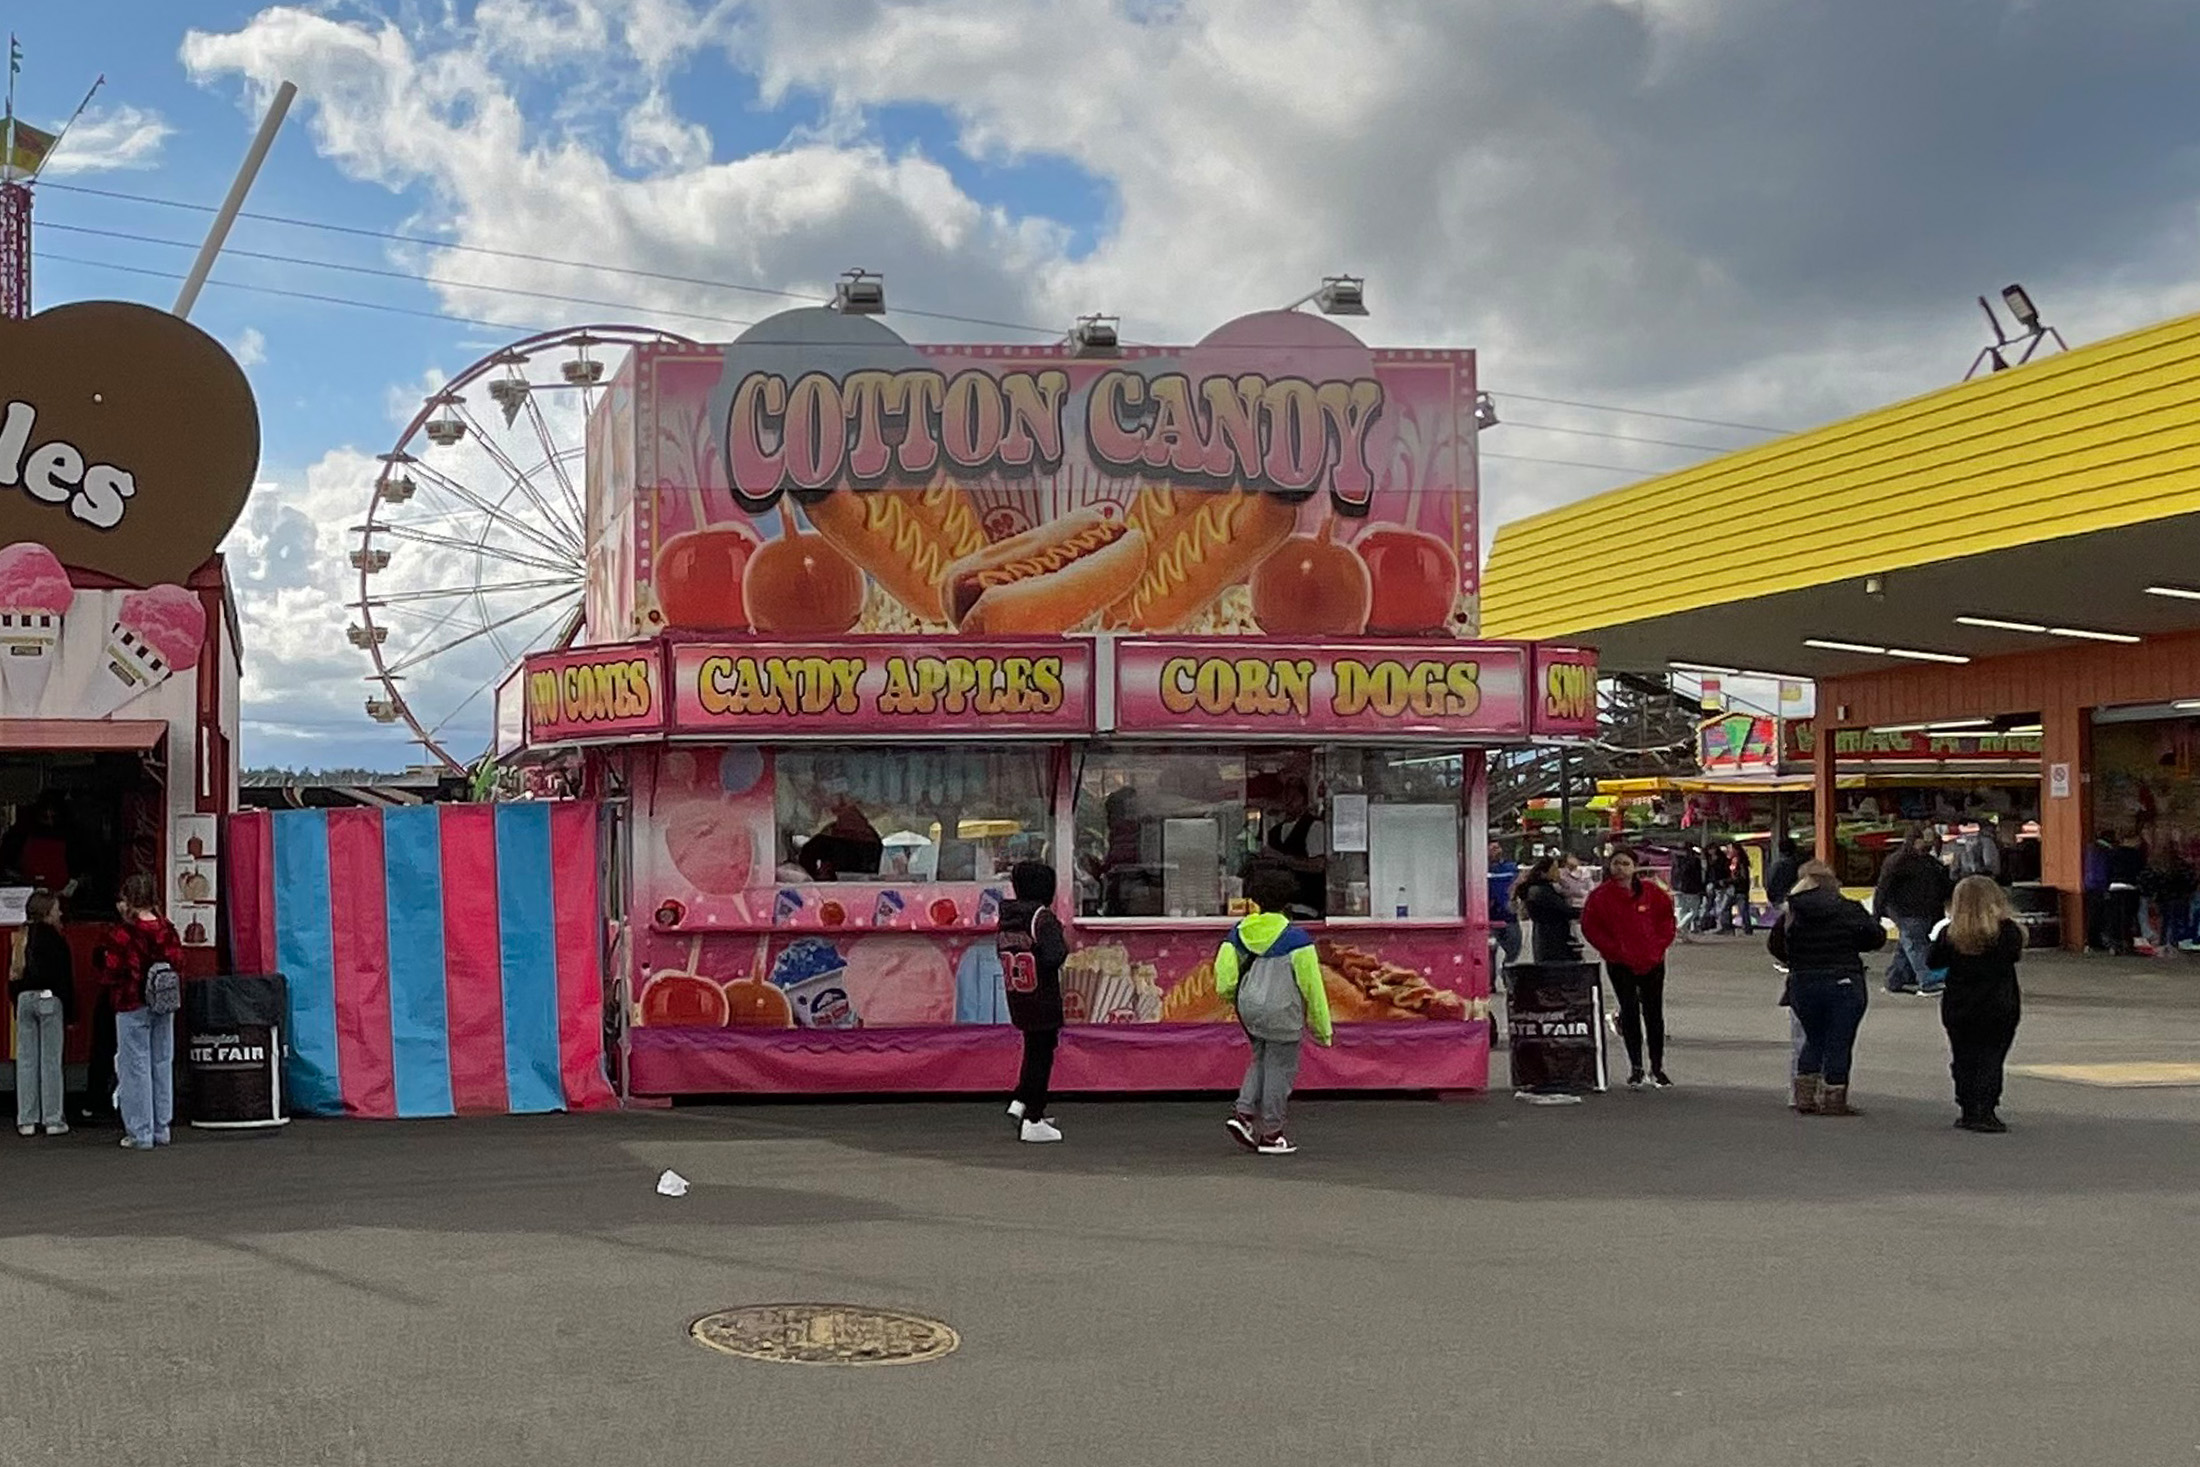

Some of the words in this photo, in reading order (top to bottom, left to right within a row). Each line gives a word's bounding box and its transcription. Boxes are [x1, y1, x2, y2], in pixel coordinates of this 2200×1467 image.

[727, 370, 1070, 512] COTTON
[1086, 371, 1384, 515] CANDY
[563, 658, 651, 723] CONES
[697, 657, 865, 716] CANDY
[877, 656, 1064, 716] APPLES
[1159, 656, 1314, 717] CORN
[1332, 659, 1481, 717] DOGS
[217, 1046, 264, 1061] FAIR
[1542, 1022, 1588, 1036] FAIR
